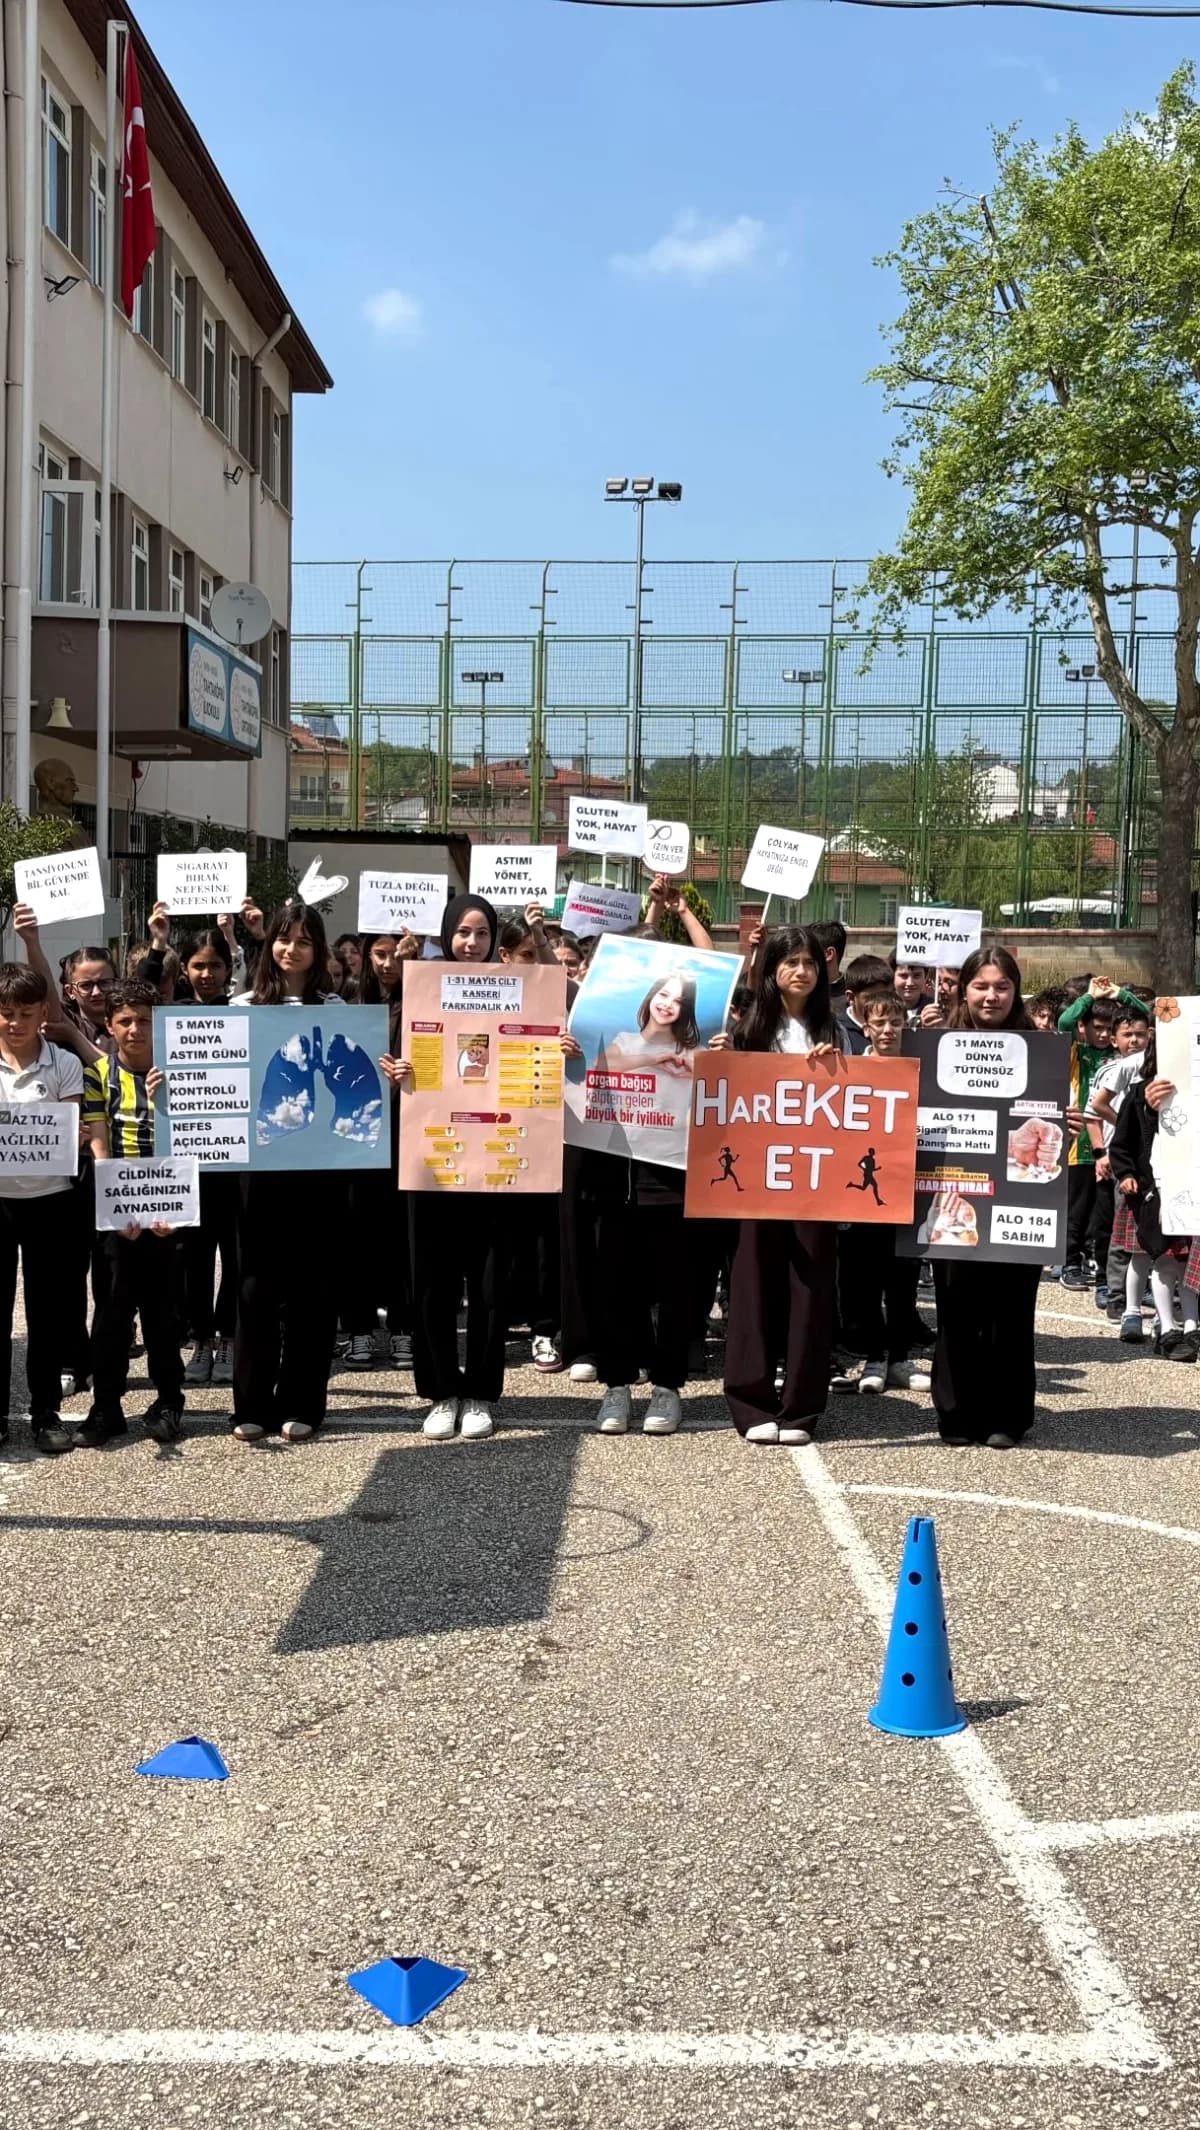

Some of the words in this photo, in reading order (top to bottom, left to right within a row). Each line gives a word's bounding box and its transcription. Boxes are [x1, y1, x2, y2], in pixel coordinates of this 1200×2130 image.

[576, 806, 618, 818] GLUTEN
[576, 819, 600, 830] YOK,
[604, 823, 637, 832] HAYAT
[576, 832, 596, 841] VAR
[176, 860, 229, 870] SİGARAYI
[496, 856, 532, 865] ASTIMI
[27, 880, 42, 890] BİL
[44, 871, 90, 886] GÜVENDE
[186, 873, 220, 882] BIRAK
[494, 869, 532, 882] YÖNET,
[176, 884, 230, 894] NEFESİNE
[368, 880, 404, 890] TUZLA
[477, 886, 517, 895] HAYATI
[520, 886, 548, 898] YAŞA
[172, 896, 209, 906] NEFES
[210, 896, 232, 905] KAT
[380, 895, 426, 905] TADIYLA
[390, 909, 416, 919] YAŞA
[906, 916, 950, 928] GLUTEN
[904, 930, 931, 942] YOK,
[934, 933, 970, 943] HAYAT
[904, 945, 926, 954] VAR
[468, 976, 496, 985] MAYIS
[442, 1002, 501, 1010] FARKINDALIK
[504, 1003, 520, 1011] AYI
[176, 1020, 183, 1030] 5
[186, 1020, 225, 1029] MAYIS
[180, 1034, 222, 1044] DÜNYA
[954, 1039, 966, 1048] 31
[970, 1040, 1004, 1048] MAYIS
[170, 1050, 208, 1060] ASTIM
[212, 1048, 248, 1059] GÜNÜ
[965, 1052, 1003, 1061] DÜNYA
[954, 1065, 1014, 1076] TÜTÜNSÜZ
[169, 1072, 207, 1081] ASTIM
[588, 1074, 619, 1088] organ
[620, 1074, 652, 1092] bağışı
[968, 1078, 999, 1088] GÜNÜ
[170, 1085, 236, 1096] KONTROLÜ
[586, 1090, 622, 1106] kalpten
[625, 1094, 654, 1108] gelen
[170, 1100, 249, 1111] KORTİZONLU
[12, 1115, 28, 1125] AZ
[30, 1115, 57, 1127] TUZ,
[585, 1106, 617, 1122] büyük
[620, 1108, 634, 1123] bir
[637, 1110, 675, 1126] iyiliktir
[932, 1113, 954, 1121] ALO
[958, 1114, 975, 1122] 171
[172, 1122, 212, 1131] NEFES
[916, 1126, 948, 1135] Sigara
[951, 1127, 994, 1136] Bırakma
[0, 1132, 60, 1145] AĞLIKLI
[173, 1136, 246, 1148] AÇICILARLA
[917, 1138, 961, 1149] Danışma
[965, 1141, 990, 1149] Hattı
[0, 1151, 50, 1164] YAŞAM
[765, 1144, 834, 1190] ET
[118, 1166, 176, 1180] CİLDİNİZ,
[104, 1184, 190, 1197] SAĞLIĞINIZIN
[113, 1202, 183, 1214] AYNASIDIR
[996, 1214, 1023, 1224] ALO
[1029, 1216, 1052, 1226] 184
[1001, 1231, 1045, 1243] SABİM
